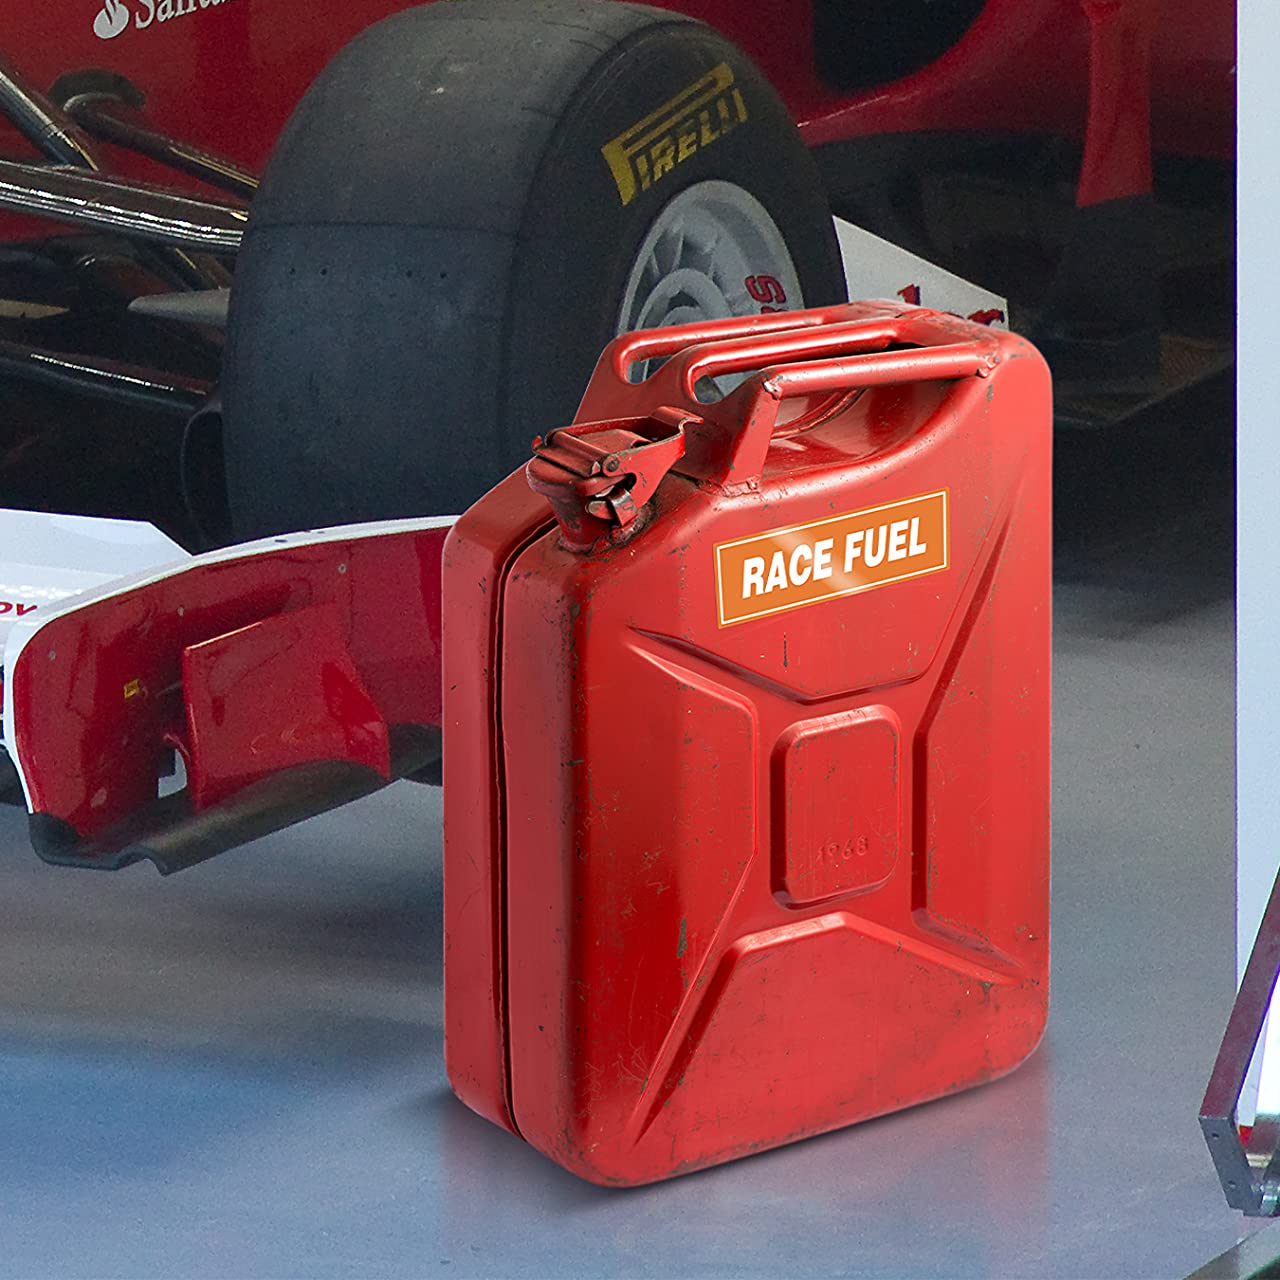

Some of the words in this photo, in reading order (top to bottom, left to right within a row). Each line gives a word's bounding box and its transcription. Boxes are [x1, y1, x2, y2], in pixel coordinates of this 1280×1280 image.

[600, 62, 748, 206] PIRELLI
[742, 538, 834, 599] RACE
[844, 517, 927, 573] FUEL
